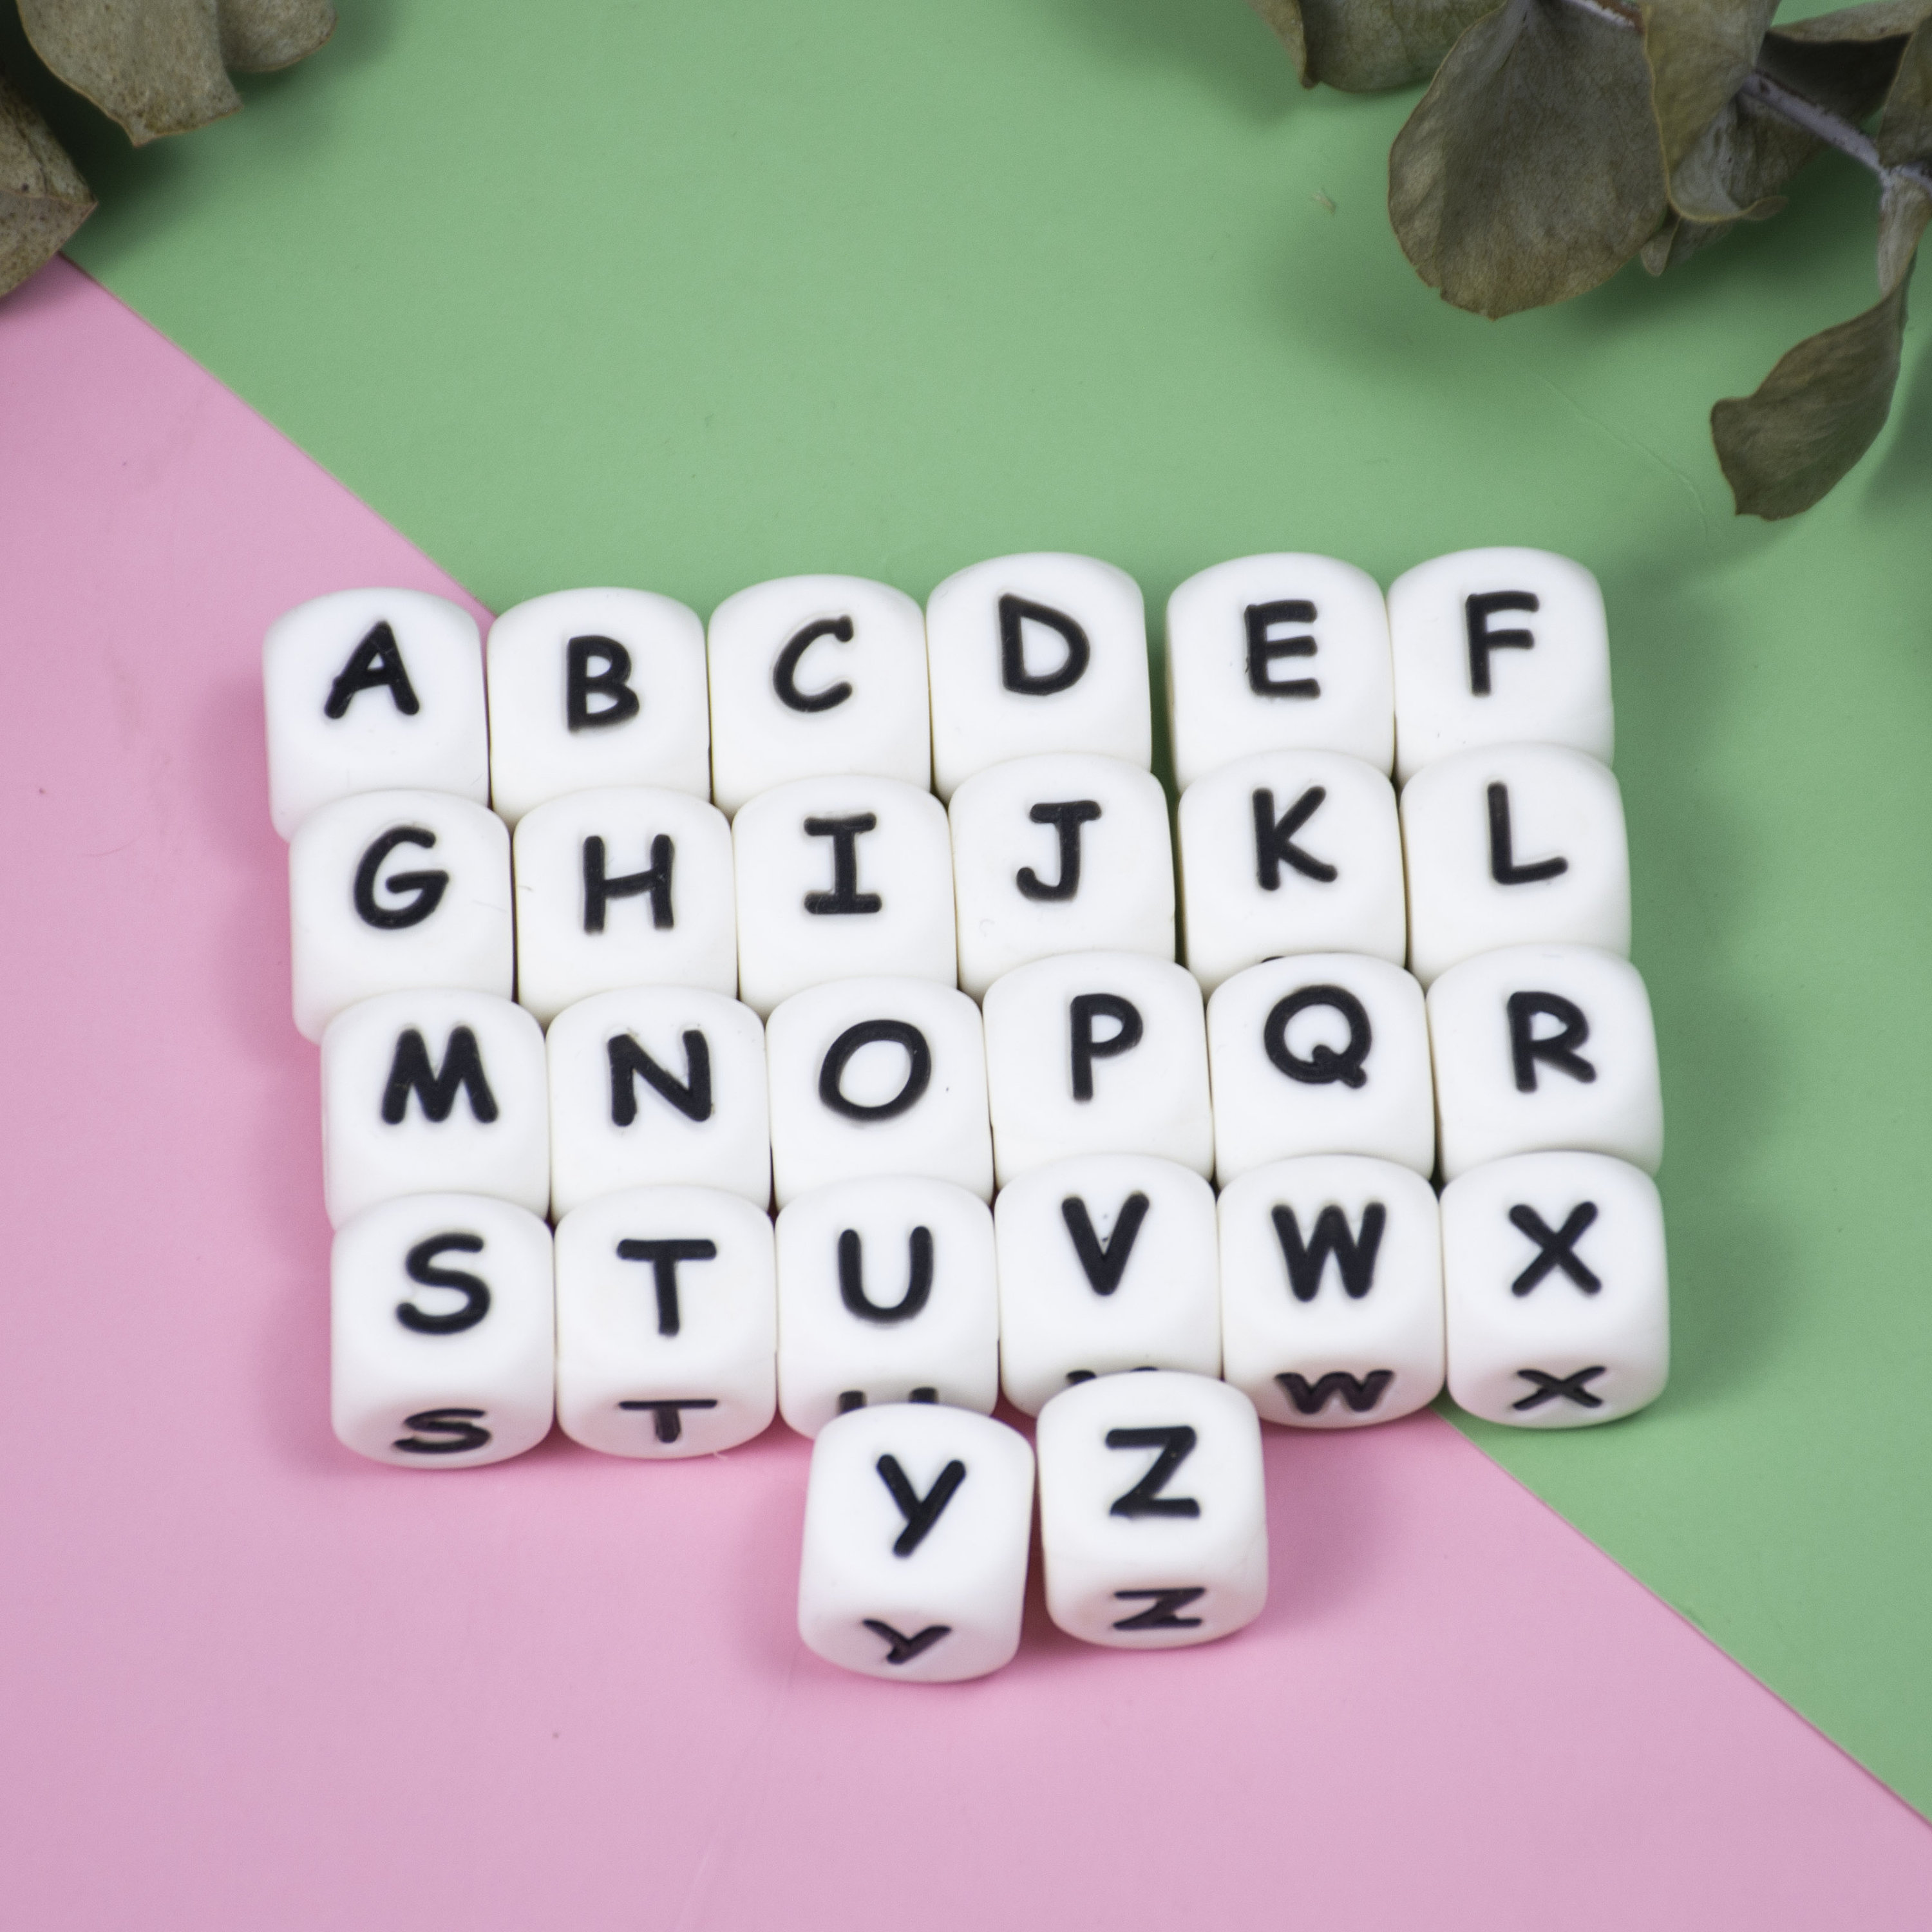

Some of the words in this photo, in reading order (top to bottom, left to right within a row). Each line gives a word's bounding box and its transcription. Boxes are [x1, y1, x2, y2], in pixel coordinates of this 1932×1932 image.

[325, 622, 419, 719] A
[567, 636, 639, 730] B
[773, 617, 853, 712] C
[999, 595, 1090, 696] D
[1244, 600, 1320, 697] E
[1466, 591, 1539, 694] F
[354, 827, 448, 929] G
[583, 835, 674, 932] H
[804, 814, 882, 914] I
[1017, 800, 1101, 900] J
[1253, 788, 1337, 891] K
[1488, 784, 1567, 885] L
[382, 1027, 498, 1124] M
[608, 1030, 712, 1126] N
[819, 1020, 931, 1121] O
[1070, 994, 1142, 1100] P
[1264, 985, 1372, 1088] Q
[1507, 992, 1595, 1092] R
[397, 1234, 490, 1334] S
[618, 1240, 716, 1337] T
[838, 1227, 933, 1323] U
[1062, 1194, 1149, 1296] V
[1272, 1204, 1385, 1300] W
[1510, 1202, 1600, 1296] X
[393, 1408, 491, 1454] S
[618, 1399, 717, 1443] T
[1274, 1370, 1393, 1414] W
[1511, 1366, 1606, 1410] X
[1106, 1426, 1200, 1517] Z
[1113, 1587, 1206, 1631] Z
